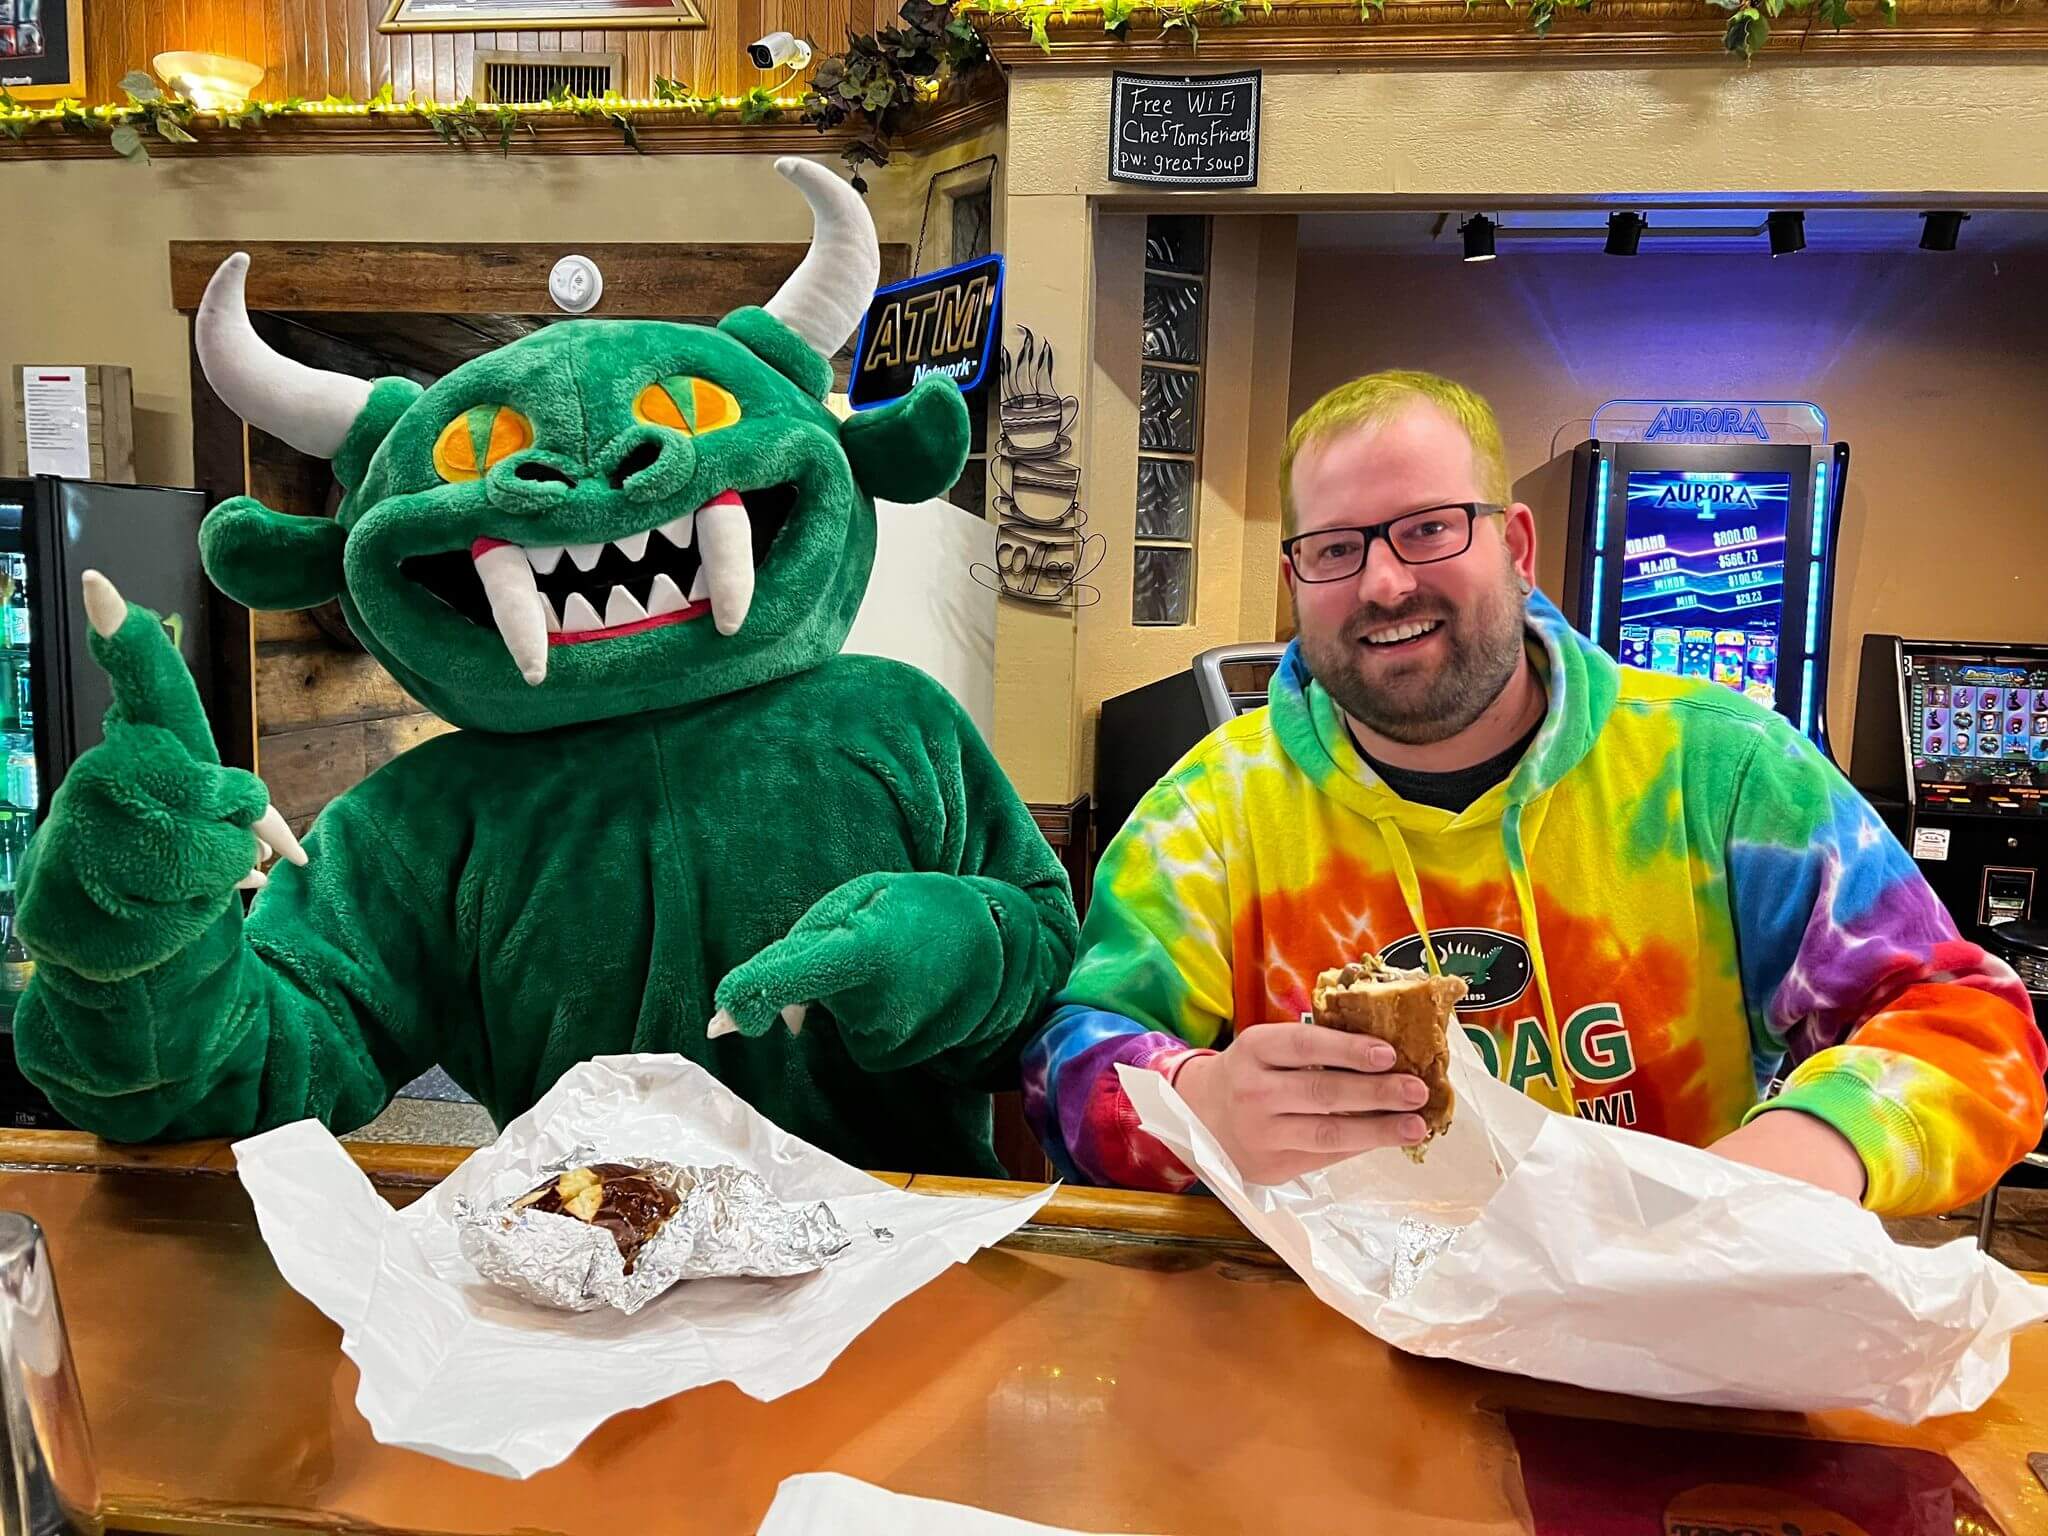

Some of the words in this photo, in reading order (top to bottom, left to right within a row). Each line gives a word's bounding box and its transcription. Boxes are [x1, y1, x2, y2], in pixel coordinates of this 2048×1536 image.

[1131, 88, 1173, 114] Free
[863, 275, 989, 372] ATM
[912, 356, 972, 387] Network
[1644, 407, 1770, 440] AURORA
[1654, 482, 1759, 510] AURORA
[1713, 525, 1758, 548] $800.00
[1639, 557, 1678, 575] MAJOR
[1654, 575, 1686, 591] MINOR
[1676, 594, 1697, 608] MINI
